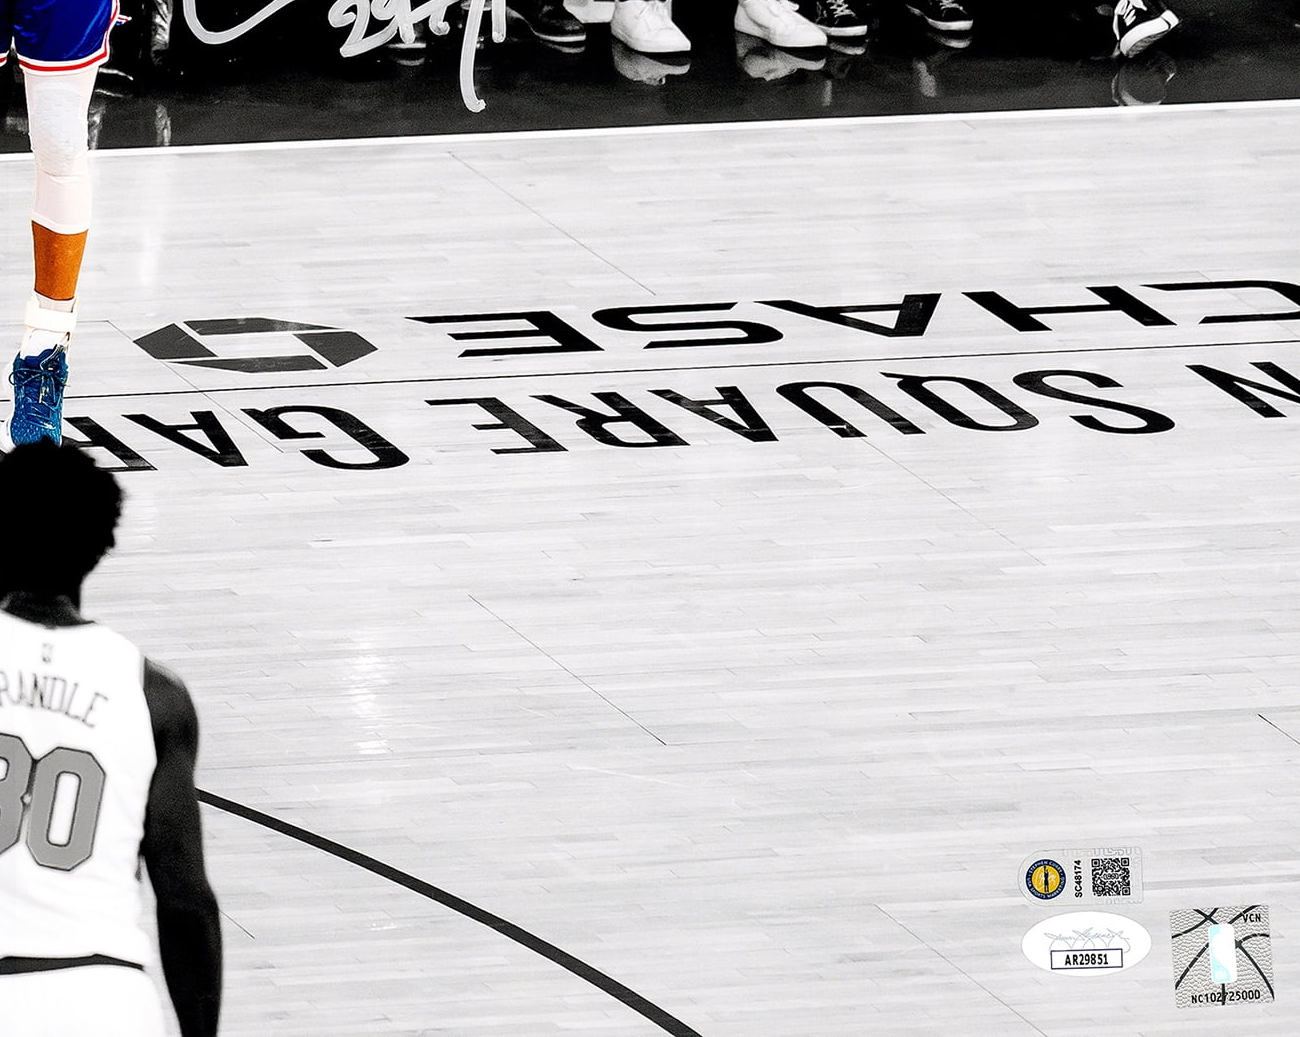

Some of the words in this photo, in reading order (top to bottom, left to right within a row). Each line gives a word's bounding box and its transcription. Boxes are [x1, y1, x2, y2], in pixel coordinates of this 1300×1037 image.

[425, 369, 1176, 455] SQUARE
[1073, 859, 1084, 899] SC48174
[1242, 913, 1262, 924] VCN
[1064, 953, 1109, 966] AR29851
